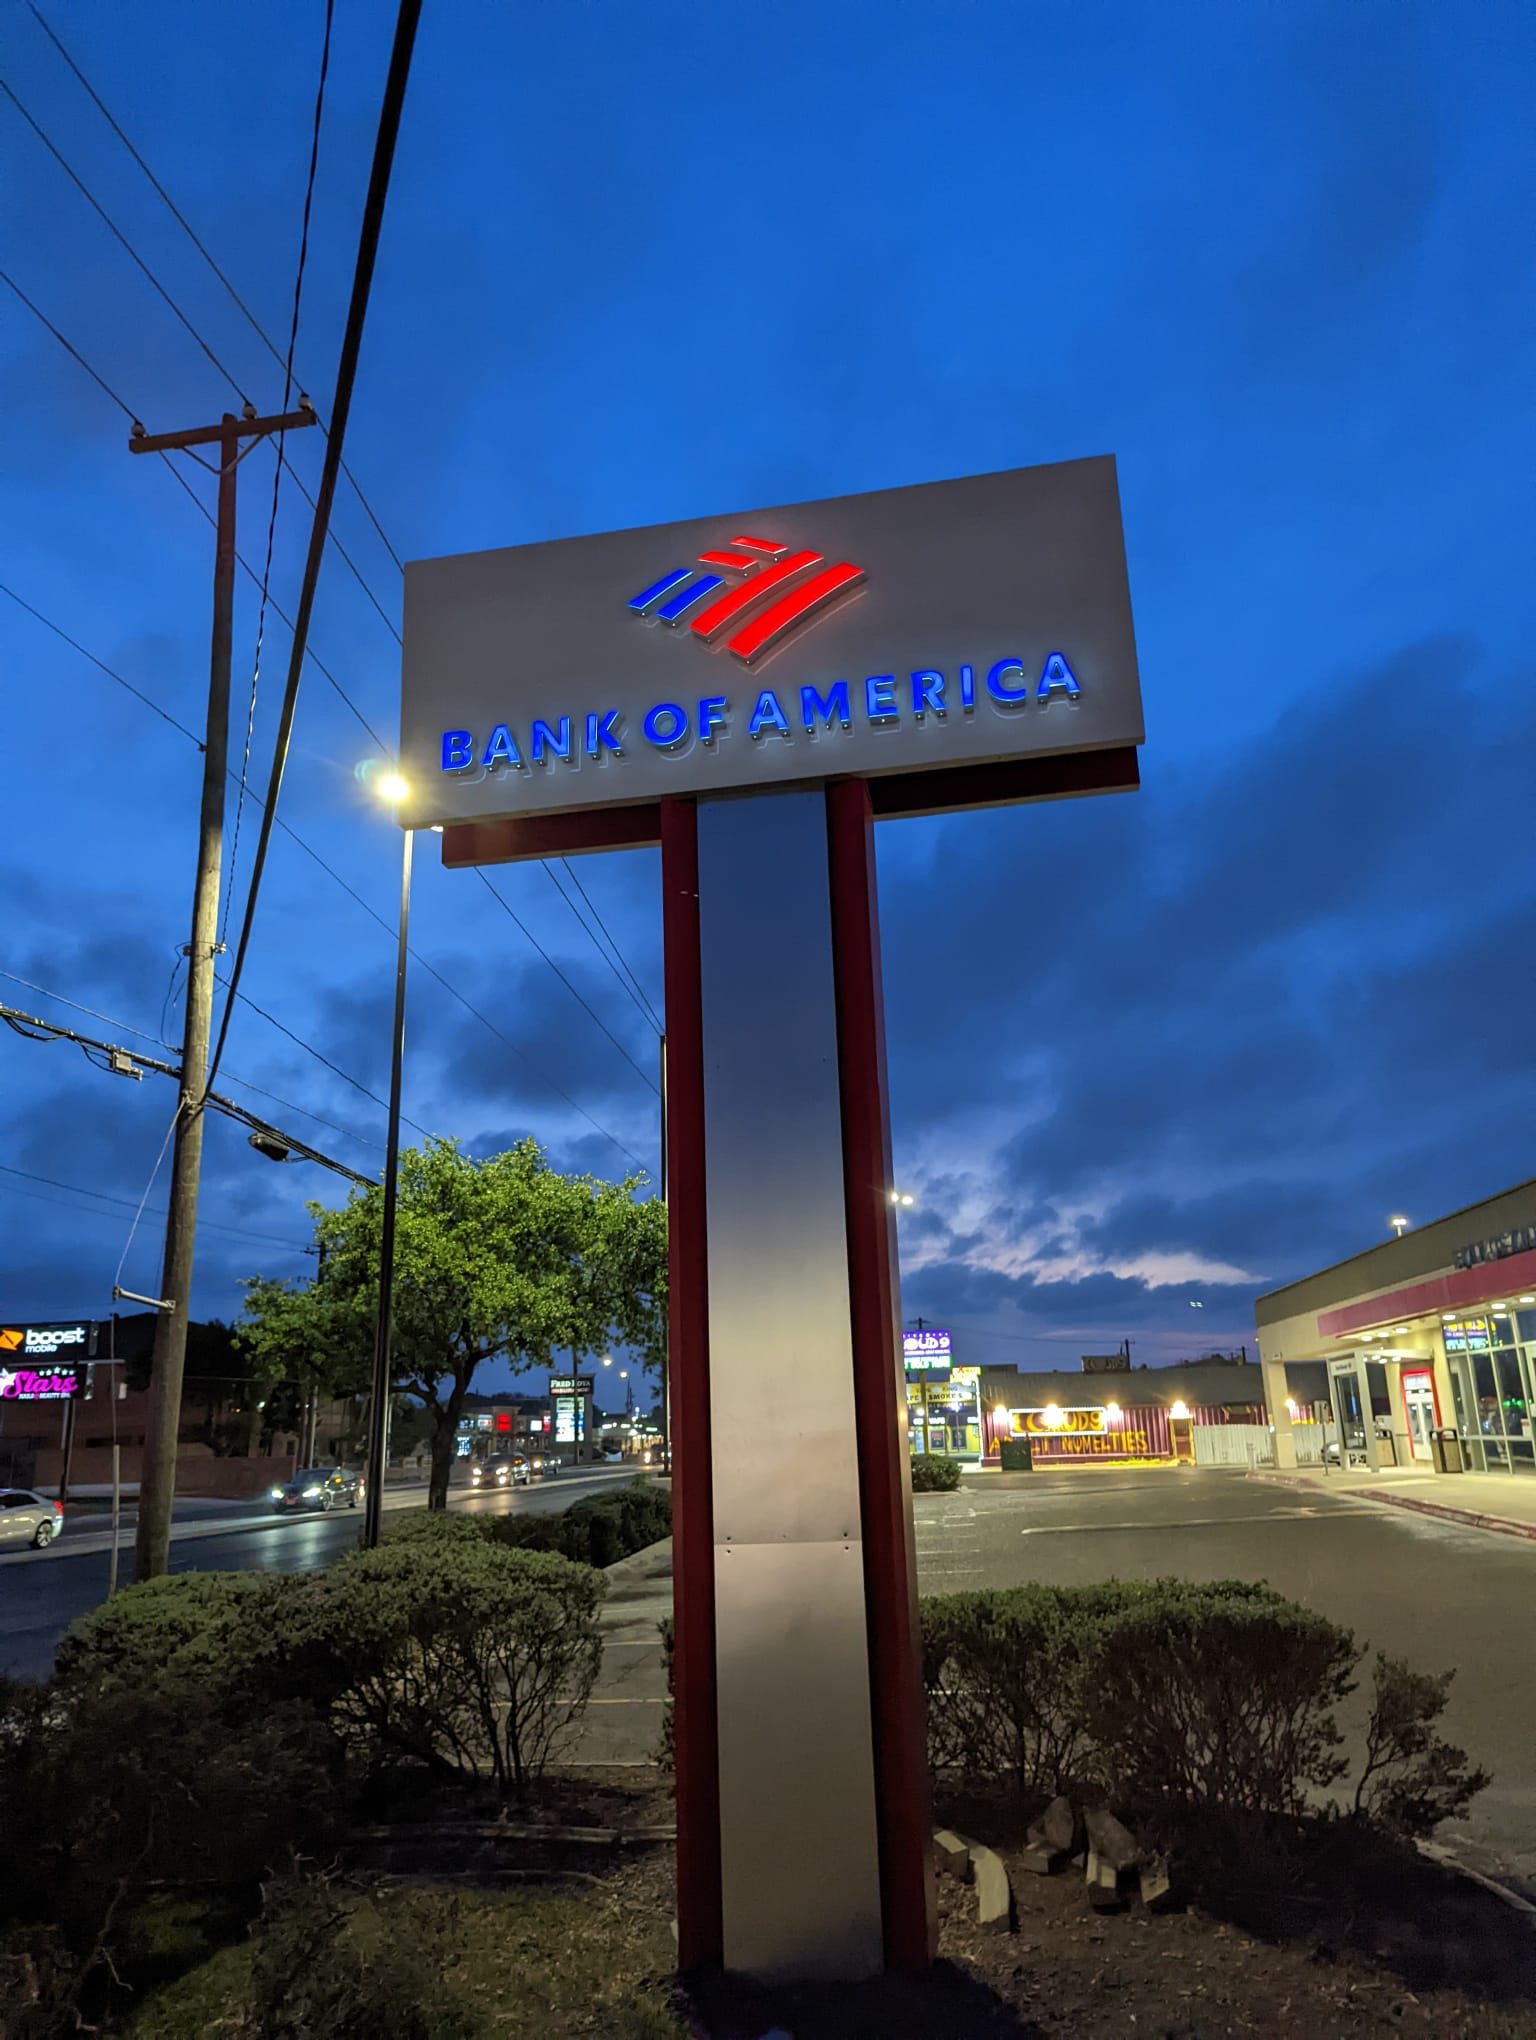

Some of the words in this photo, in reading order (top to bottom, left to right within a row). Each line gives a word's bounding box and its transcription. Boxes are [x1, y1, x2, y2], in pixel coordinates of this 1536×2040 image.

[442, 711, 625, 774] BANK
[643, 697, 730, 750] OF
[747, 651, 1083, 739] AMERICA
[25, 1327, 85, 1345] boost
[25, 1344, 58, 1354] mobile
[3, 1370, 79, 1398] Stars
